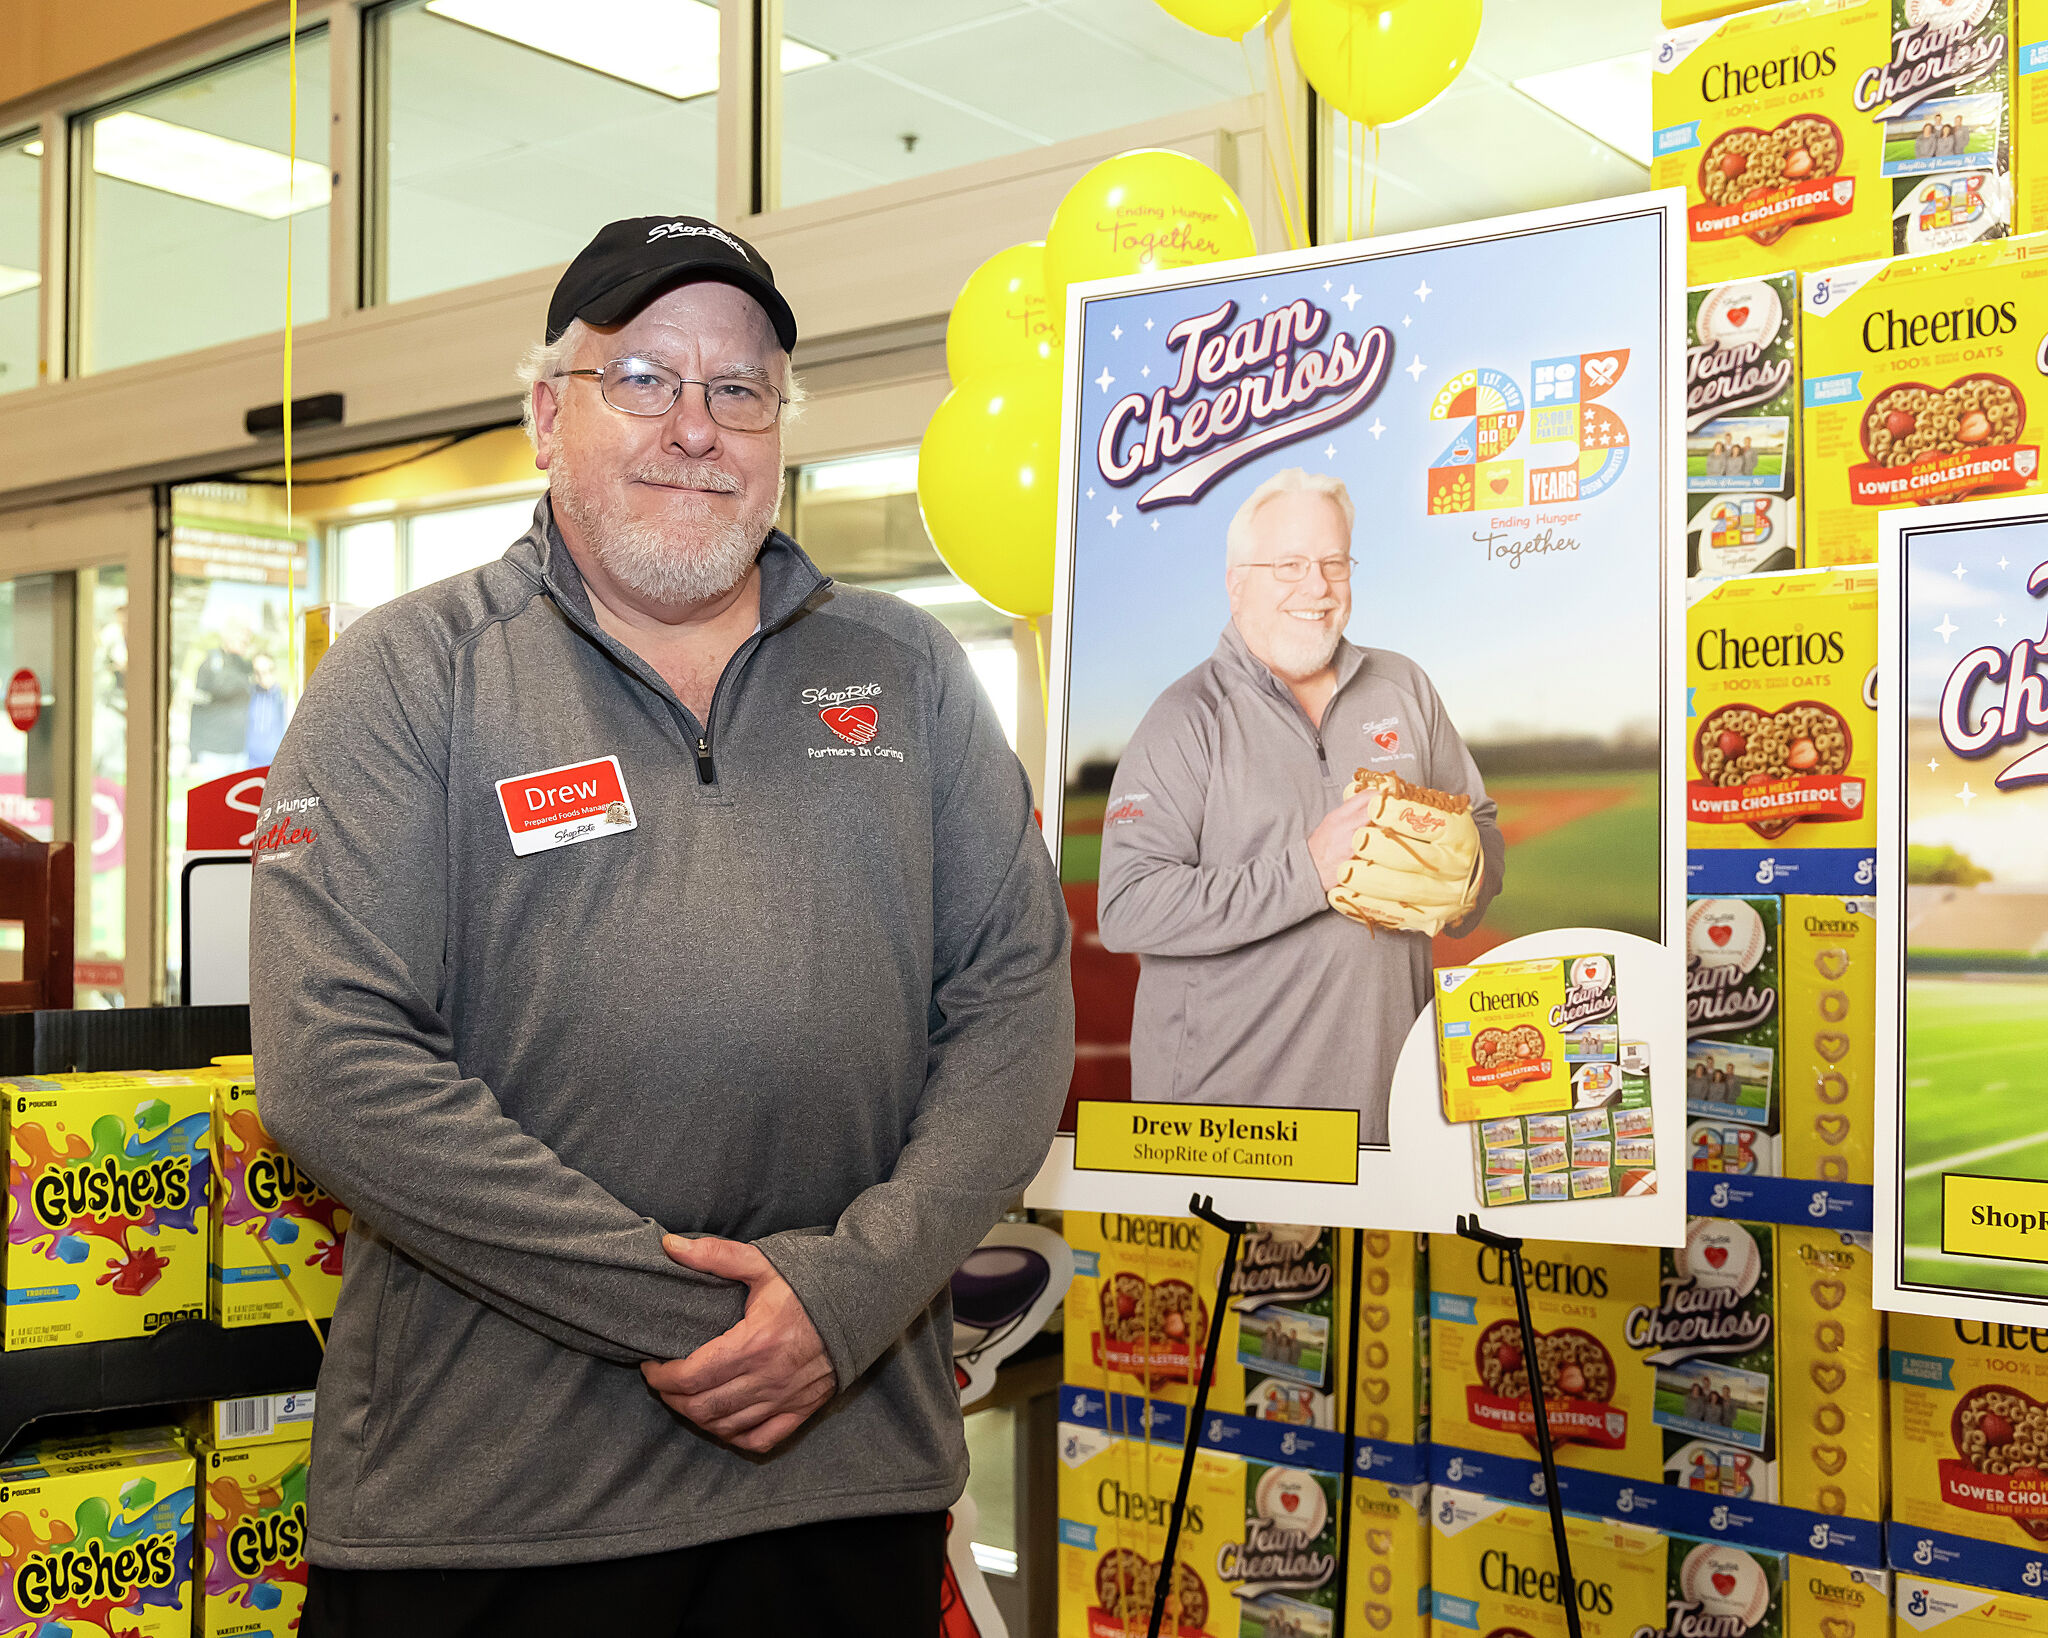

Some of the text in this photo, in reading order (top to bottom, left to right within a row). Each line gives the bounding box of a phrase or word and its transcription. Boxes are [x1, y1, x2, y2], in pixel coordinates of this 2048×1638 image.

[1891, 20, 1973, 69] Team
[1702, 46, 1837, 102] Cheerios
[1853, 34, 2005, 112] Cheerios
[1788, 87, 1825, 105] OATS
[1117, 206, 1219, 222] Ending Hunger
[1695, 191, 1831, 233] LOWER CHOLESTEROL
[646, 222, 752, 263] ShopRite
[1096, 222, 1220, 264] Together
[1863, 301, 2018, 353] Cheerios
[1166, 299, 1331, 403] Team
[1687, 340, 1761, 385] Team
[1890, 345, 2004, 372] 100% OATS
[1687, 359, 1791, 409] eerios
[1097, 325, 1395, 488] Cheerios
[1858, 459, 2010, 495] LOWER CHOLESTEROL
[1912, 454, 1971, 475] CAN HELP
[1532, 470, 1578, 501] YEARS
[1491, 512, 1582, 529] Ending Hunger
[1472, 528, 1581, 569] Together
[1697, 628, 1844, 671] Cheerios
[801, 682, 883, 708] ShopRite
[1723, 674, 1831, 691] 100% OATS
[808, 745, 904, 763] Partners In Caring
[524, 779, 598, 812] Drew
[1692, 799, 1740, 813] LOWER
[1741, 788, 1837, 811] CHOLESTEROL
[1742, 780, 1800, 798] CAN HELP
[276, 796, 320, 814] Hunger
[524, 803, 610, 828] Prepared Foods Manage
[257, 816, 319, 851] ether
[554, 823, 597, 844] ShopRite
[1804, 916, 1860, 932] Cheerios
[1687, 955, 1744, 994] eam
[1470, 990, 1539, 1014] Cheerios
[1565, 984, 1603, 1007] Team
[1687, 986, 1775, 1022] erios
[1549, 994, 1617, 1028] Cheerios
[1472, 1073, 1496, 1083] LOWER
[1496, 1065, 1541, 1081] CHOLESTEROL
[17, 1097, 57, 1112] 6 POUCHES
[230, 1085, 239, 1101] 6
[1132, 1115, 1298, 1142] Drew Bylenski
[1133, 1143, 1293, 1167] ShopRite of Canton
[35, 1158, 189, 1226] Gushers
[1971, 1205, 2048, 1235] ShopR
[26, 1288, 60, 1298] TROPICAL
[1661, 1275, 1739, 1317] Team
[1625, 1305, 1771, 1349] Cheerios
[1985, 1358, 2031, 1375] 100%
[1474, 1402, 1516, 1422] LOWER
[1518, 1410, 1603, 1428] CHESTEROL
[212, 1453, 249, 1468] 6 POUCHES
[0, 1486, 41, 1502] 6 POUCHES
[1950, 1480, 2005, 1504] LOWER
[2009, 1480, 2037, 1491] CAN
[1246, 1517, 1310, 1553] Team
[18, 1534, 174, 1615] Gushers
[217, 1622, 262, 1637] VARIETY PACK
[1667, 1600, 1747, 1638] Team
